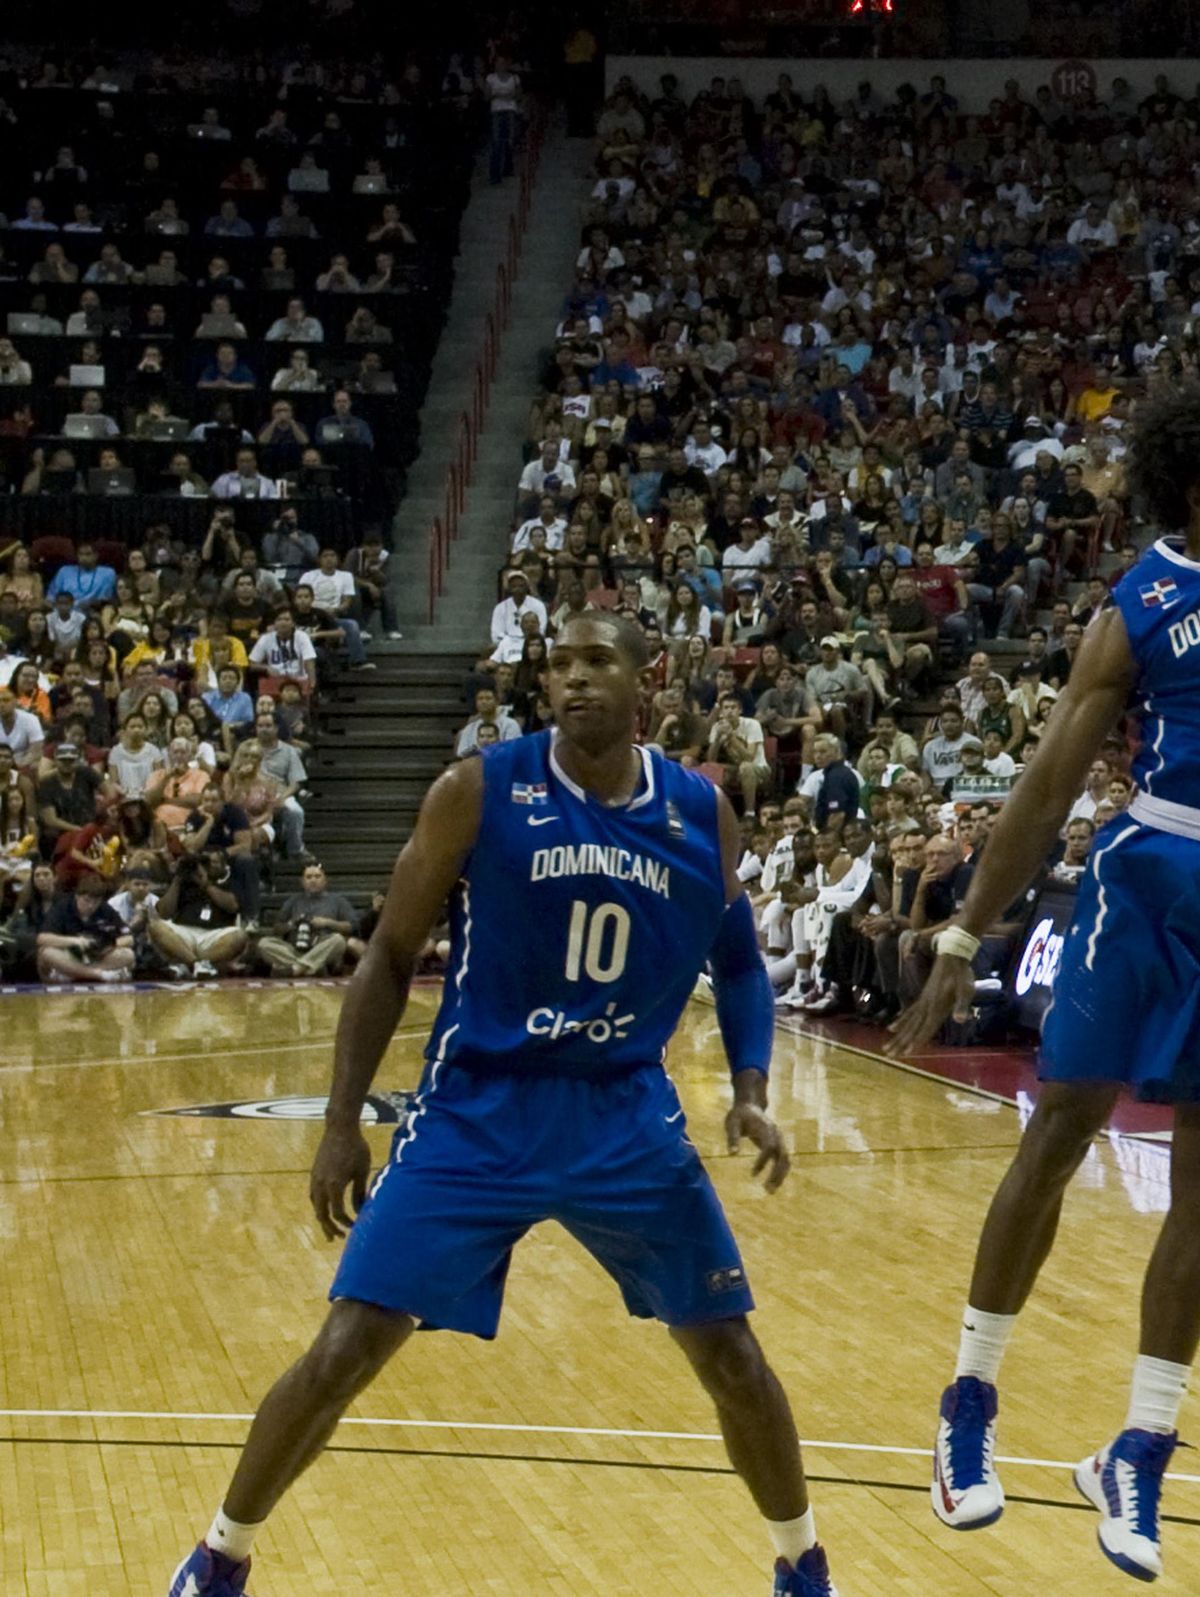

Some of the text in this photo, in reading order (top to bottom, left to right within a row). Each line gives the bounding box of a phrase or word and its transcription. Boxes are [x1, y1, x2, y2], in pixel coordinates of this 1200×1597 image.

[1058, 70, 1088, 95] 113
[531, 844, 670, 899] DOMINICANA
[565, 900, 631, 984] 10
